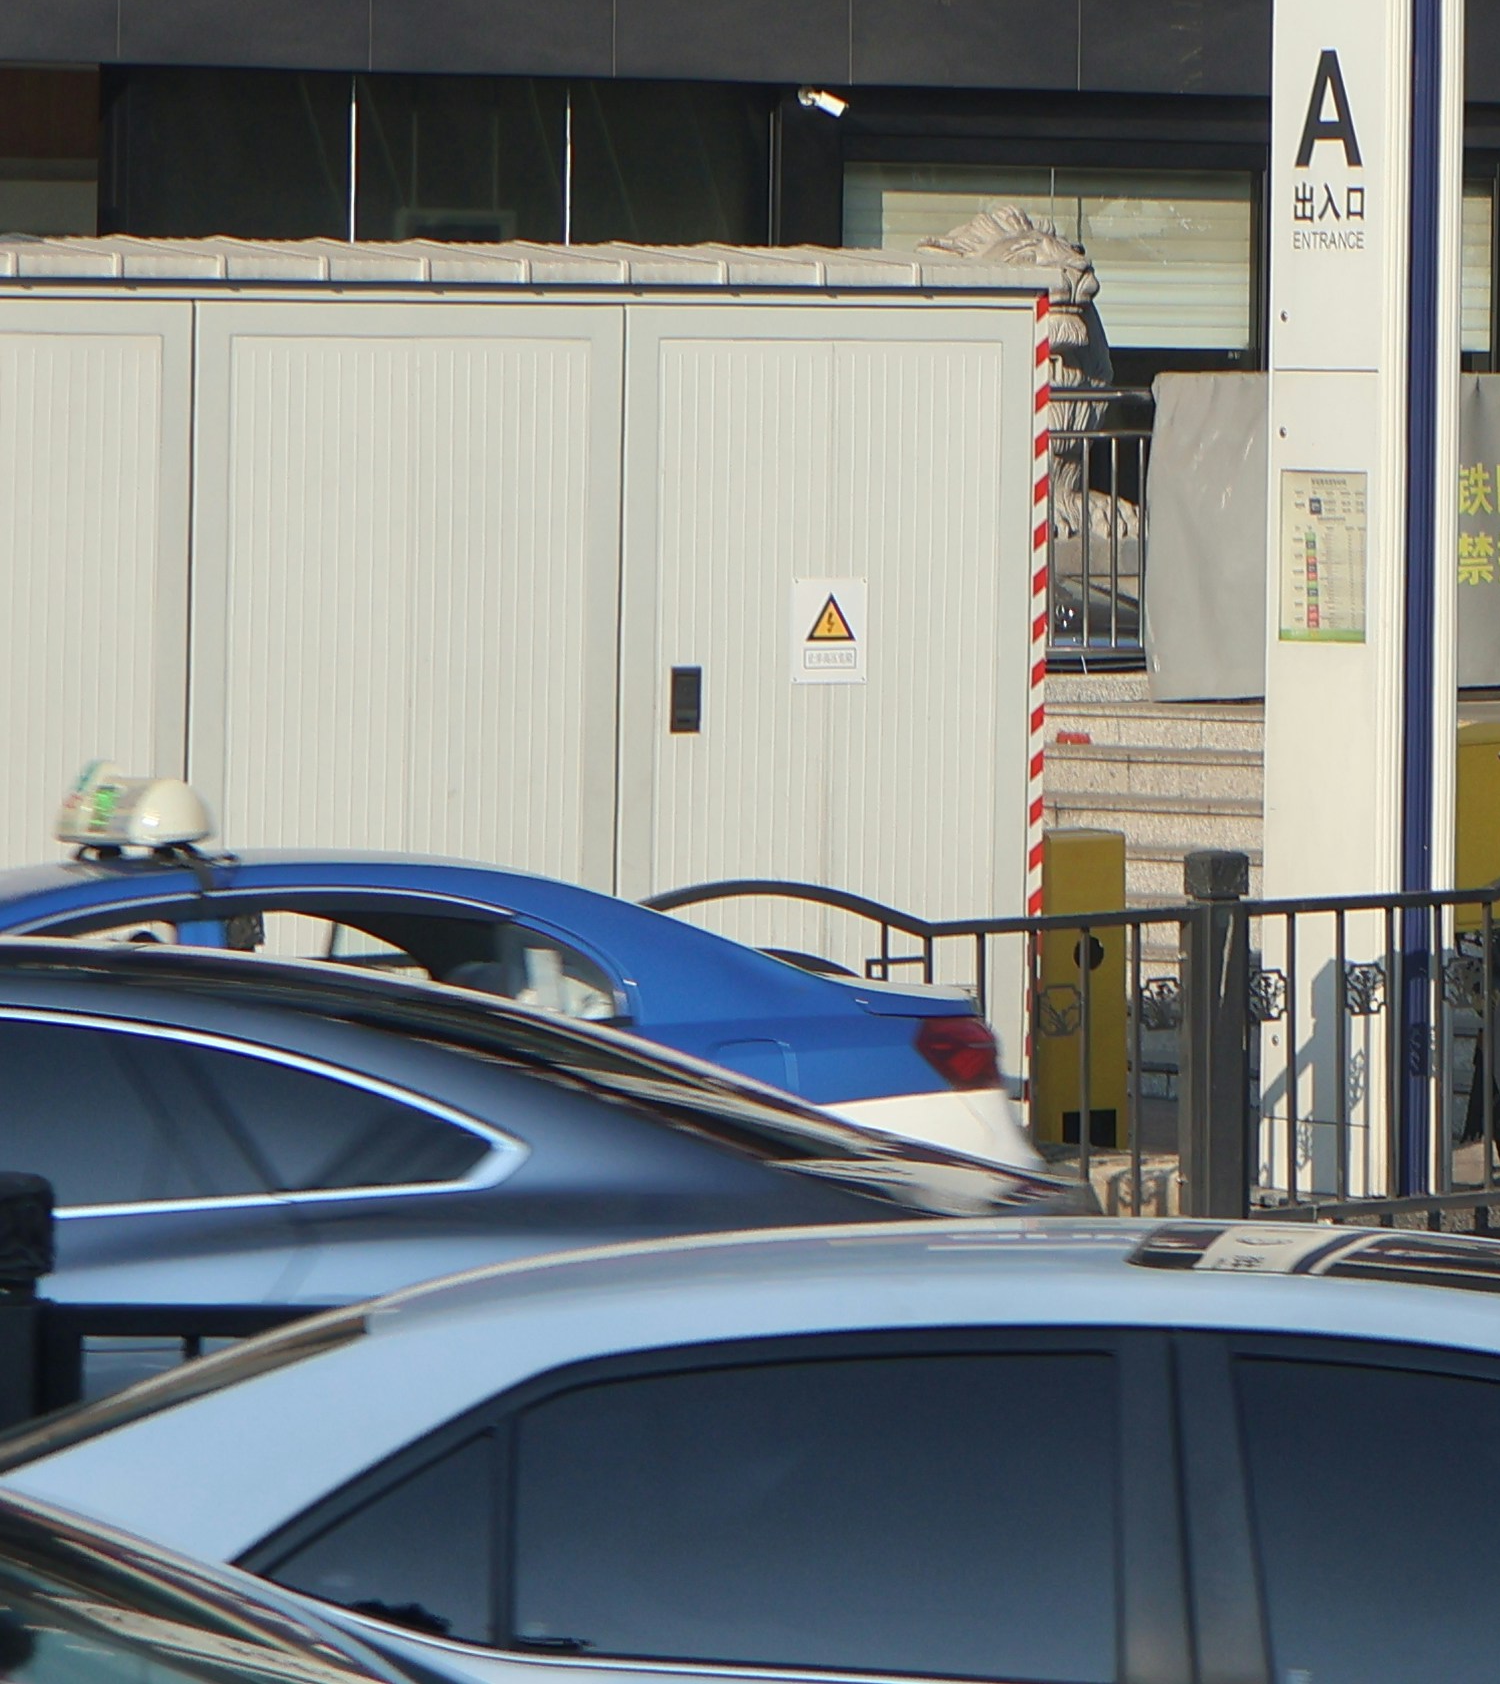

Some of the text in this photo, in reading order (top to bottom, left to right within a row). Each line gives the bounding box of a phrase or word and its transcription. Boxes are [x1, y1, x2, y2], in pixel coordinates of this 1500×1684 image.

[1295, 49, 1363, 167] A
[1294, 182, 1364, 223] 出入口
[1293, 231, 1365, 250] ENTRANCE
